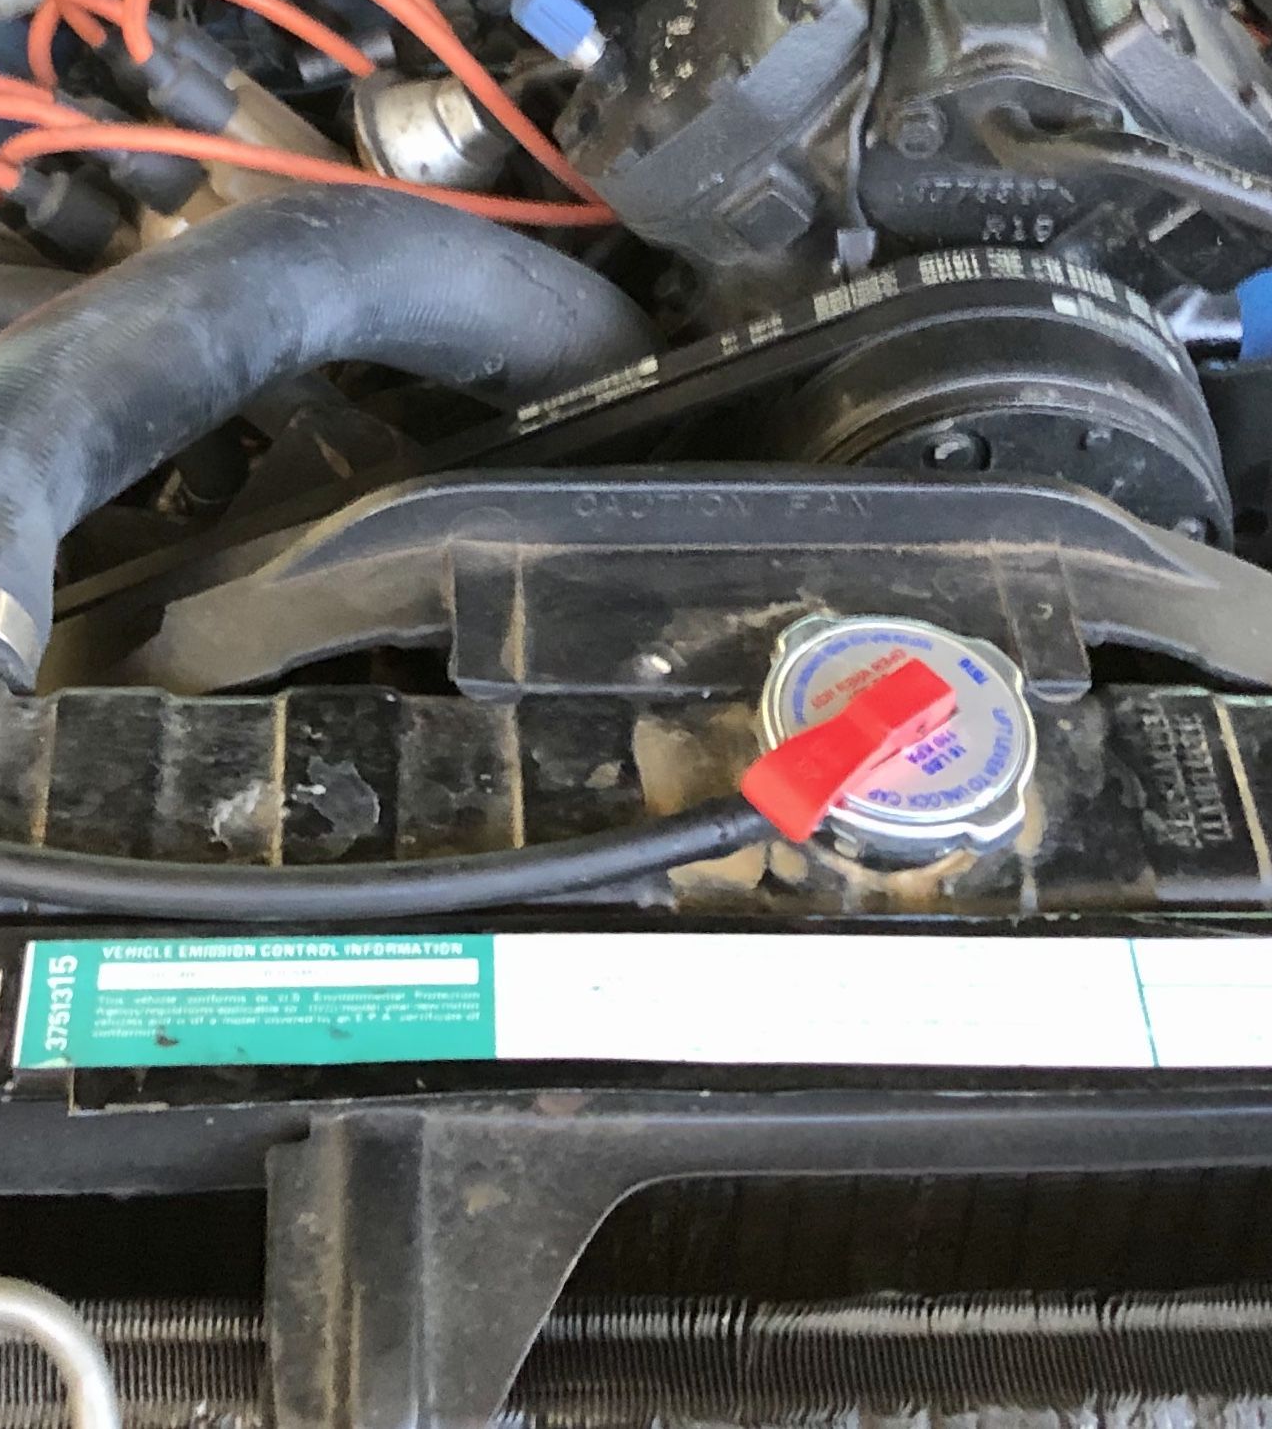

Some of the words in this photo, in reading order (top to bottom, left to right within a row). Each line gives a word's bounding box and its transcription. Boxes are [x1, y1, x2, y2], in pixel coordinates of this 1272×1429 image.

[572, 491, 753, 520] CAUTION
[785, 491, 873, 519] FAN
[868, 788, 902, 807] CAP
[102, 944, 174, 960] VEHICLE
[178, 943, 256, 959] EMISSION
[260, 942, 340, 958] CONTROL
[343, 942, 464, 958] INFORMATION
[44, 954, 79, 1052] 3751315
